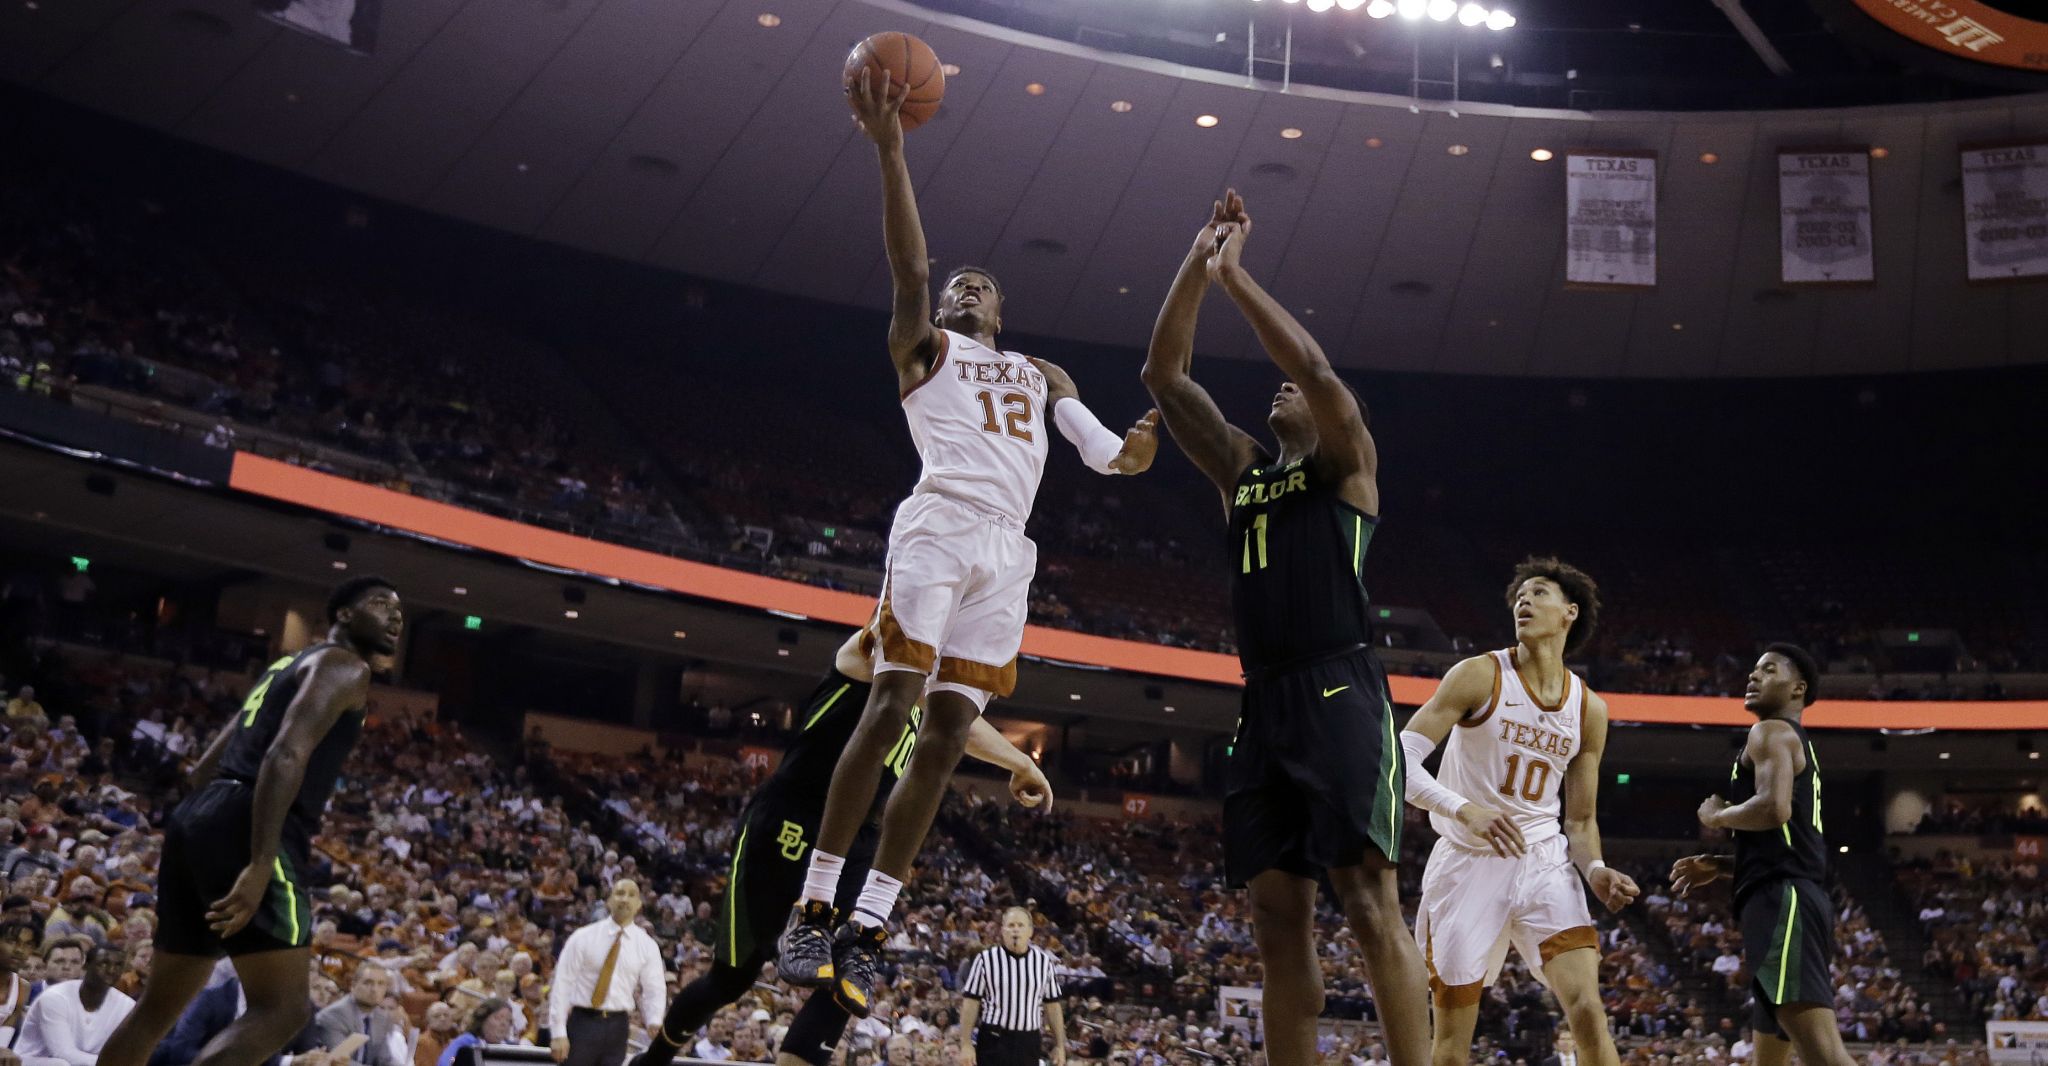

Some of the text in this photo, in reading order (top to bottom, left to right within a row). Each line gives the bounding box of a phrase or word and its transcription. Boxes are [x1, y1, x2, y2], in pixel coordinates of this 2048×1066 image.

[1585, 158, 1638, 172] TEXAS
[1797, 156, 1850, 169] TEXAS
[953, 358, 1043, 397] TEXAS
[975, 389, 1034, 446] 12
[1242, 513, 1268, 574] 11
[243, 673, 275, 728] 4
[884, 722, 917, 779] 10
[1498, 716, 1573, 759] TEXAS
[744, 752, 769, 768] 48
[1498, 753, 1550, 804] 10
[1126, 800, 1146, 814] 47
[776, 819, 809, 861] BU
[2017, 839, 2039, 856] 44
